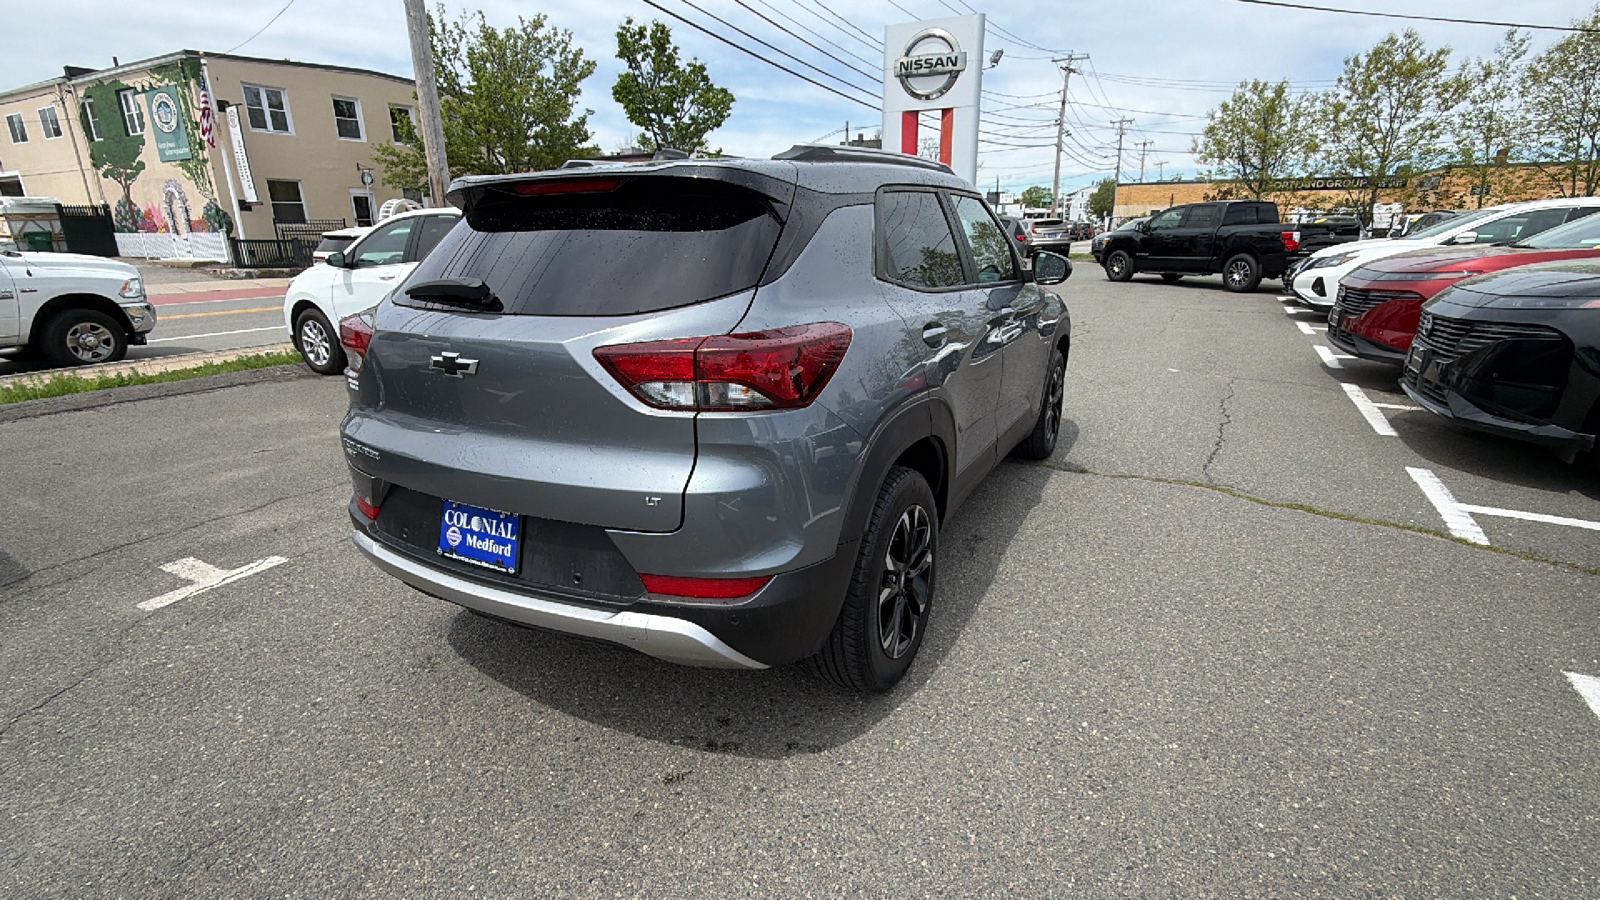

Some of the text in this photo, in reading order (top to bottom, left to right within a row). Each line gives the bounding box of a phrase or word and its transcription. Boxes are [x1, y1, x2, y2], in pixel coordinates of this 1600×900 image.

[900, 56, 958, 72] NISSAN
[1327, 178, 1368, 188] GROUP
[645, 496, 662, 506] LT
[444, 509, 516, 540] COLONIAL
[466, 533, 512, 557] Medford
